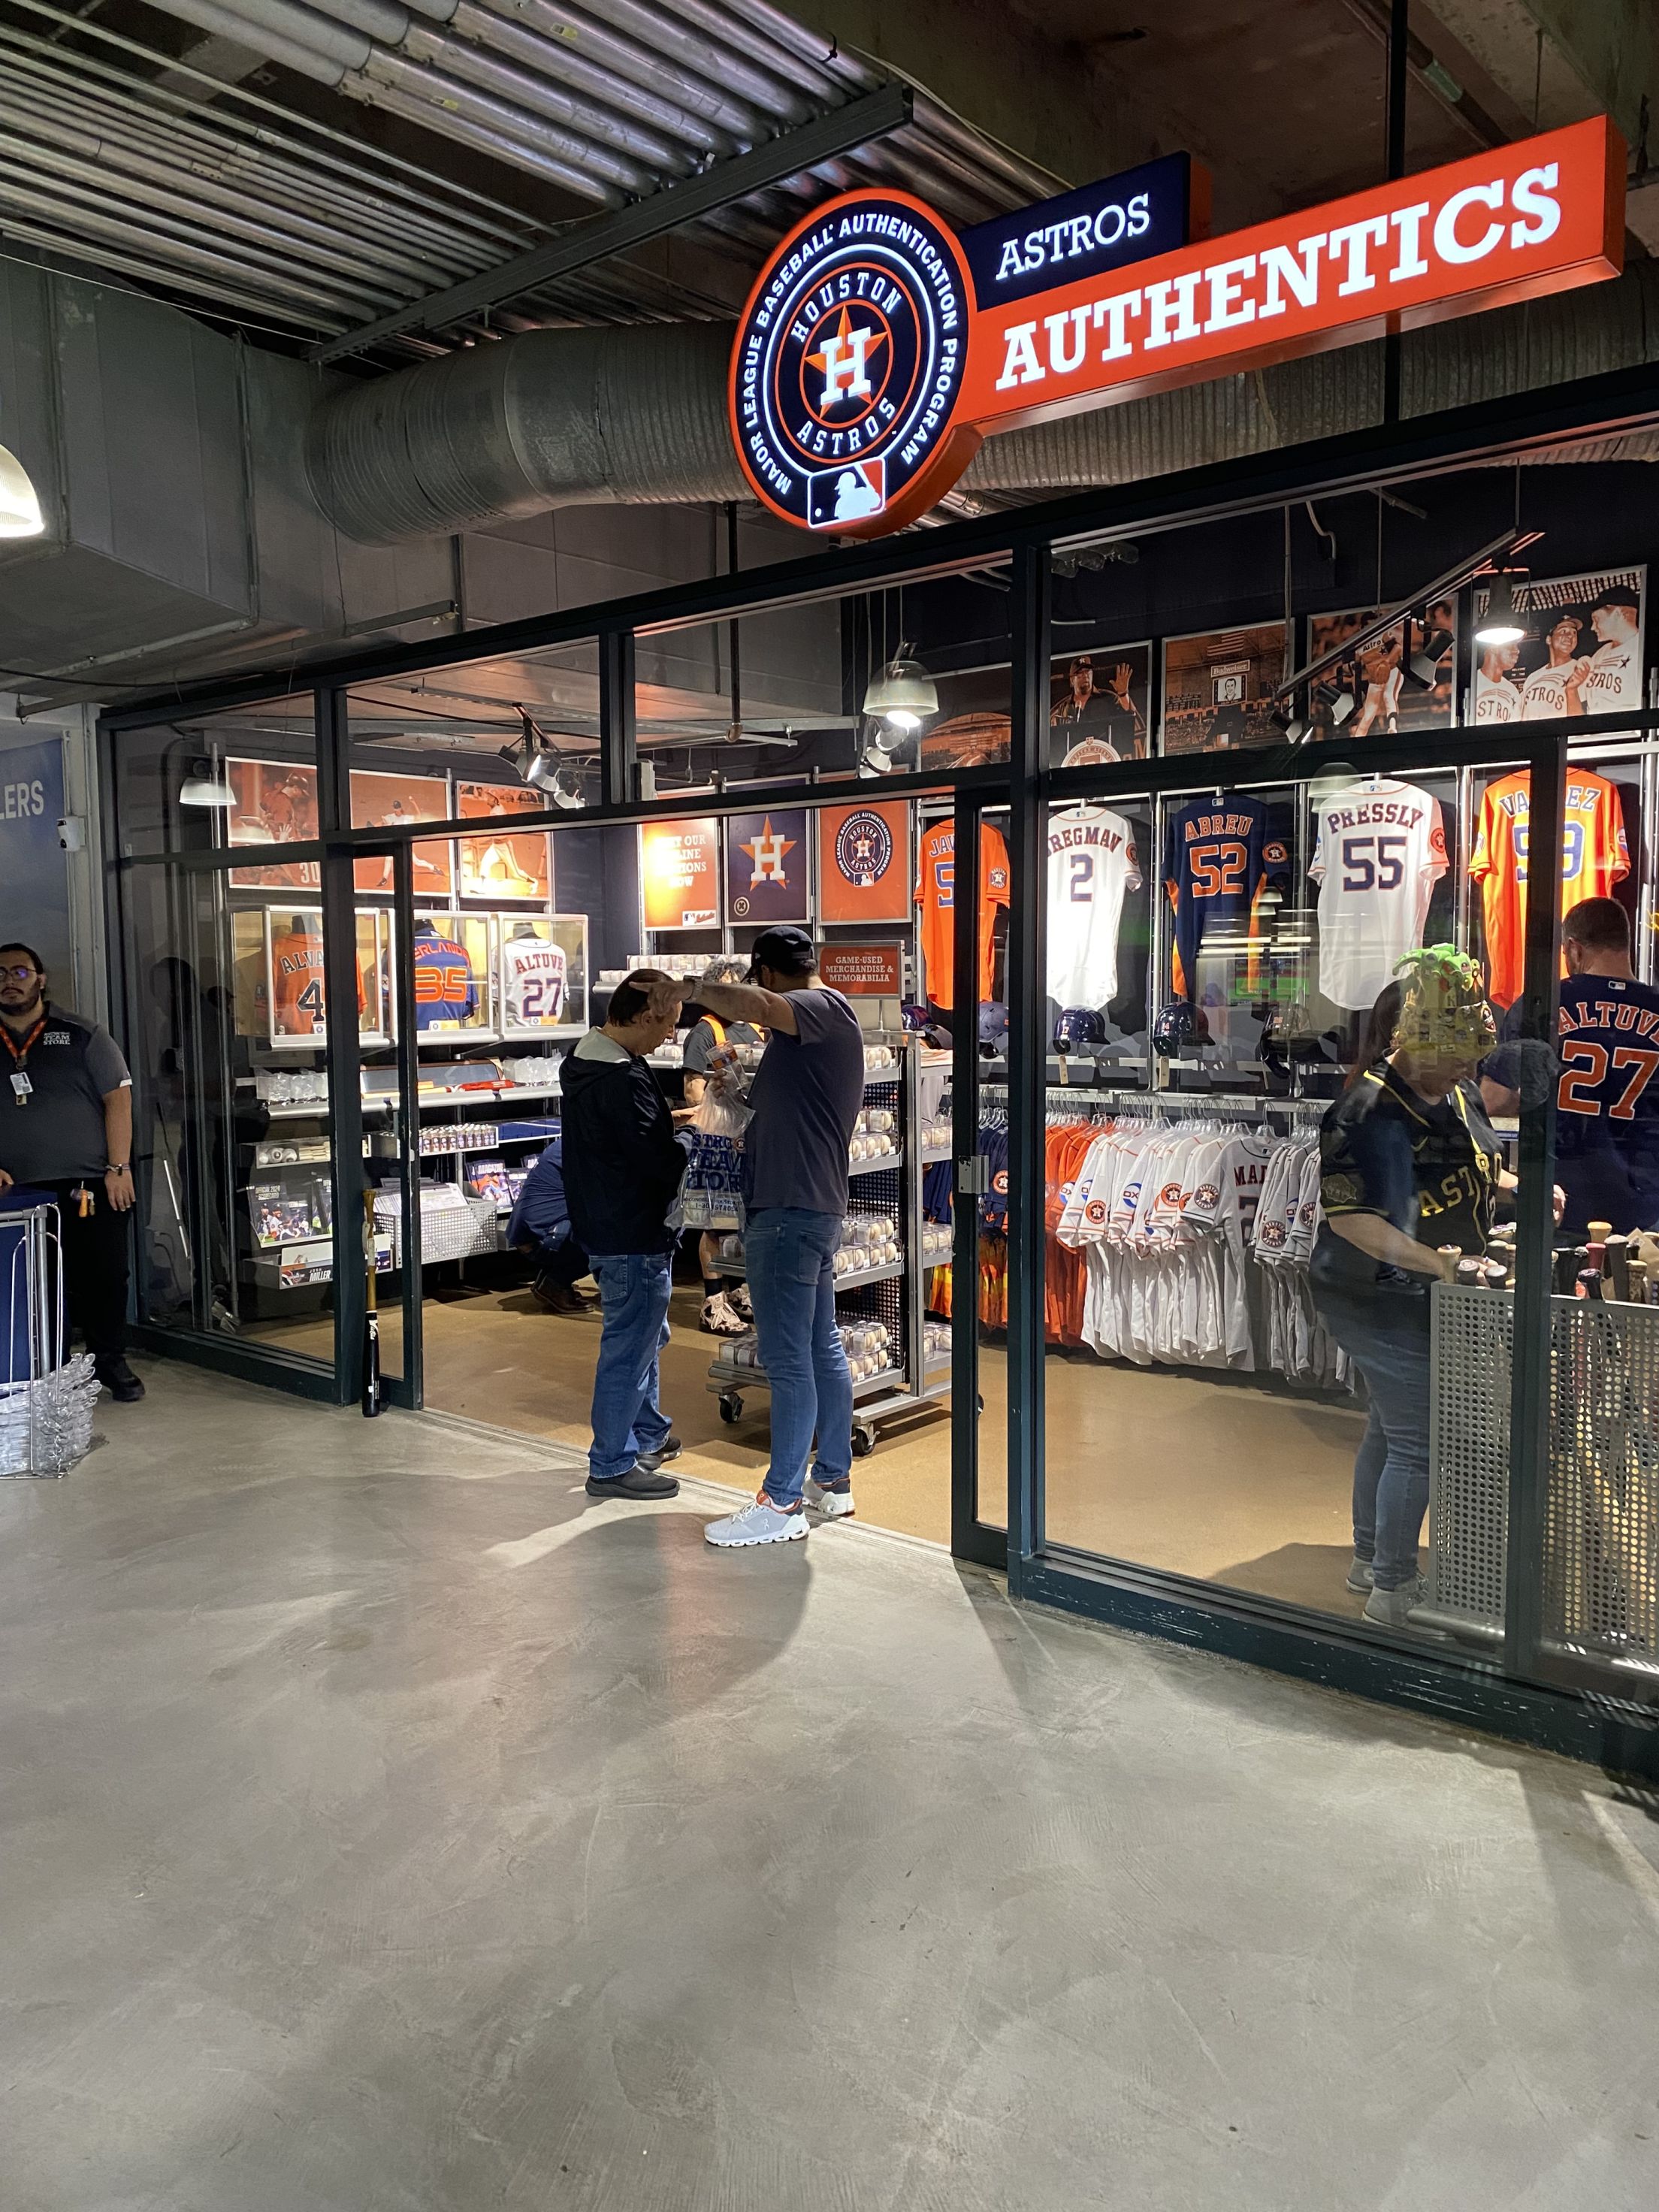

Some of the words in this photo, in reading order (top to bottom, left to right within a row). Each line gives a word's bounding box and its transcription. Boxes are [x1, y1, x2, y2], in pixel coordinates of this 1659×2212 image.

[996, 192, 1150, 282] ASTROS
[756, 231, 833, 328] BASEBALL
[839, 213, 958, 330] AUTHENTICATION
[996, 162, 1561, 391] AUTHENTICS
[790, 272, 902, 343] HOUSTON
[743, 335, 763, 428] LEAGUE
[820, 327, 872, 406] H
[901, 337, 959, 466] PROGRAM
[797, 397, 896, 455] ASTROS
[750, 431, 792, 495] MAJOR
[1478, 700, 1510, 721] STRO
[1328, 803, 1424, 834] PRESSLY
[1500, 785, 1601, 817] VAEZ
[684, 835, 706, 846] OUR
[840, 813, 860, 835] BASEBALL
[861, 812, 890, 846] AUTHENTICATION
[877, 847, 891, 875] PROGRAM
[849, 826, 878, 840] HOUSTON
[1047, 826, 1123, 855] REGMAN
[1185, 814, 1253, 842] ABREU
[670, 876, 694, 887] OW
[751, 835, 785, 881] H
[851, 857, 876, 870] ASTROS
[1071, 854, 1093, 902] 2
[1189, 842, 1247, 898] 52
[1342, 836, 1407, 892] 55
[415, 966, 467, 1002] 35
[515, 953, 564, 975] ALTUVE
[523, 978, 562, 1018] 27
[1558, 1040, 1659, 1120] 27
[310, 1270, 331, 1282] MILLER
